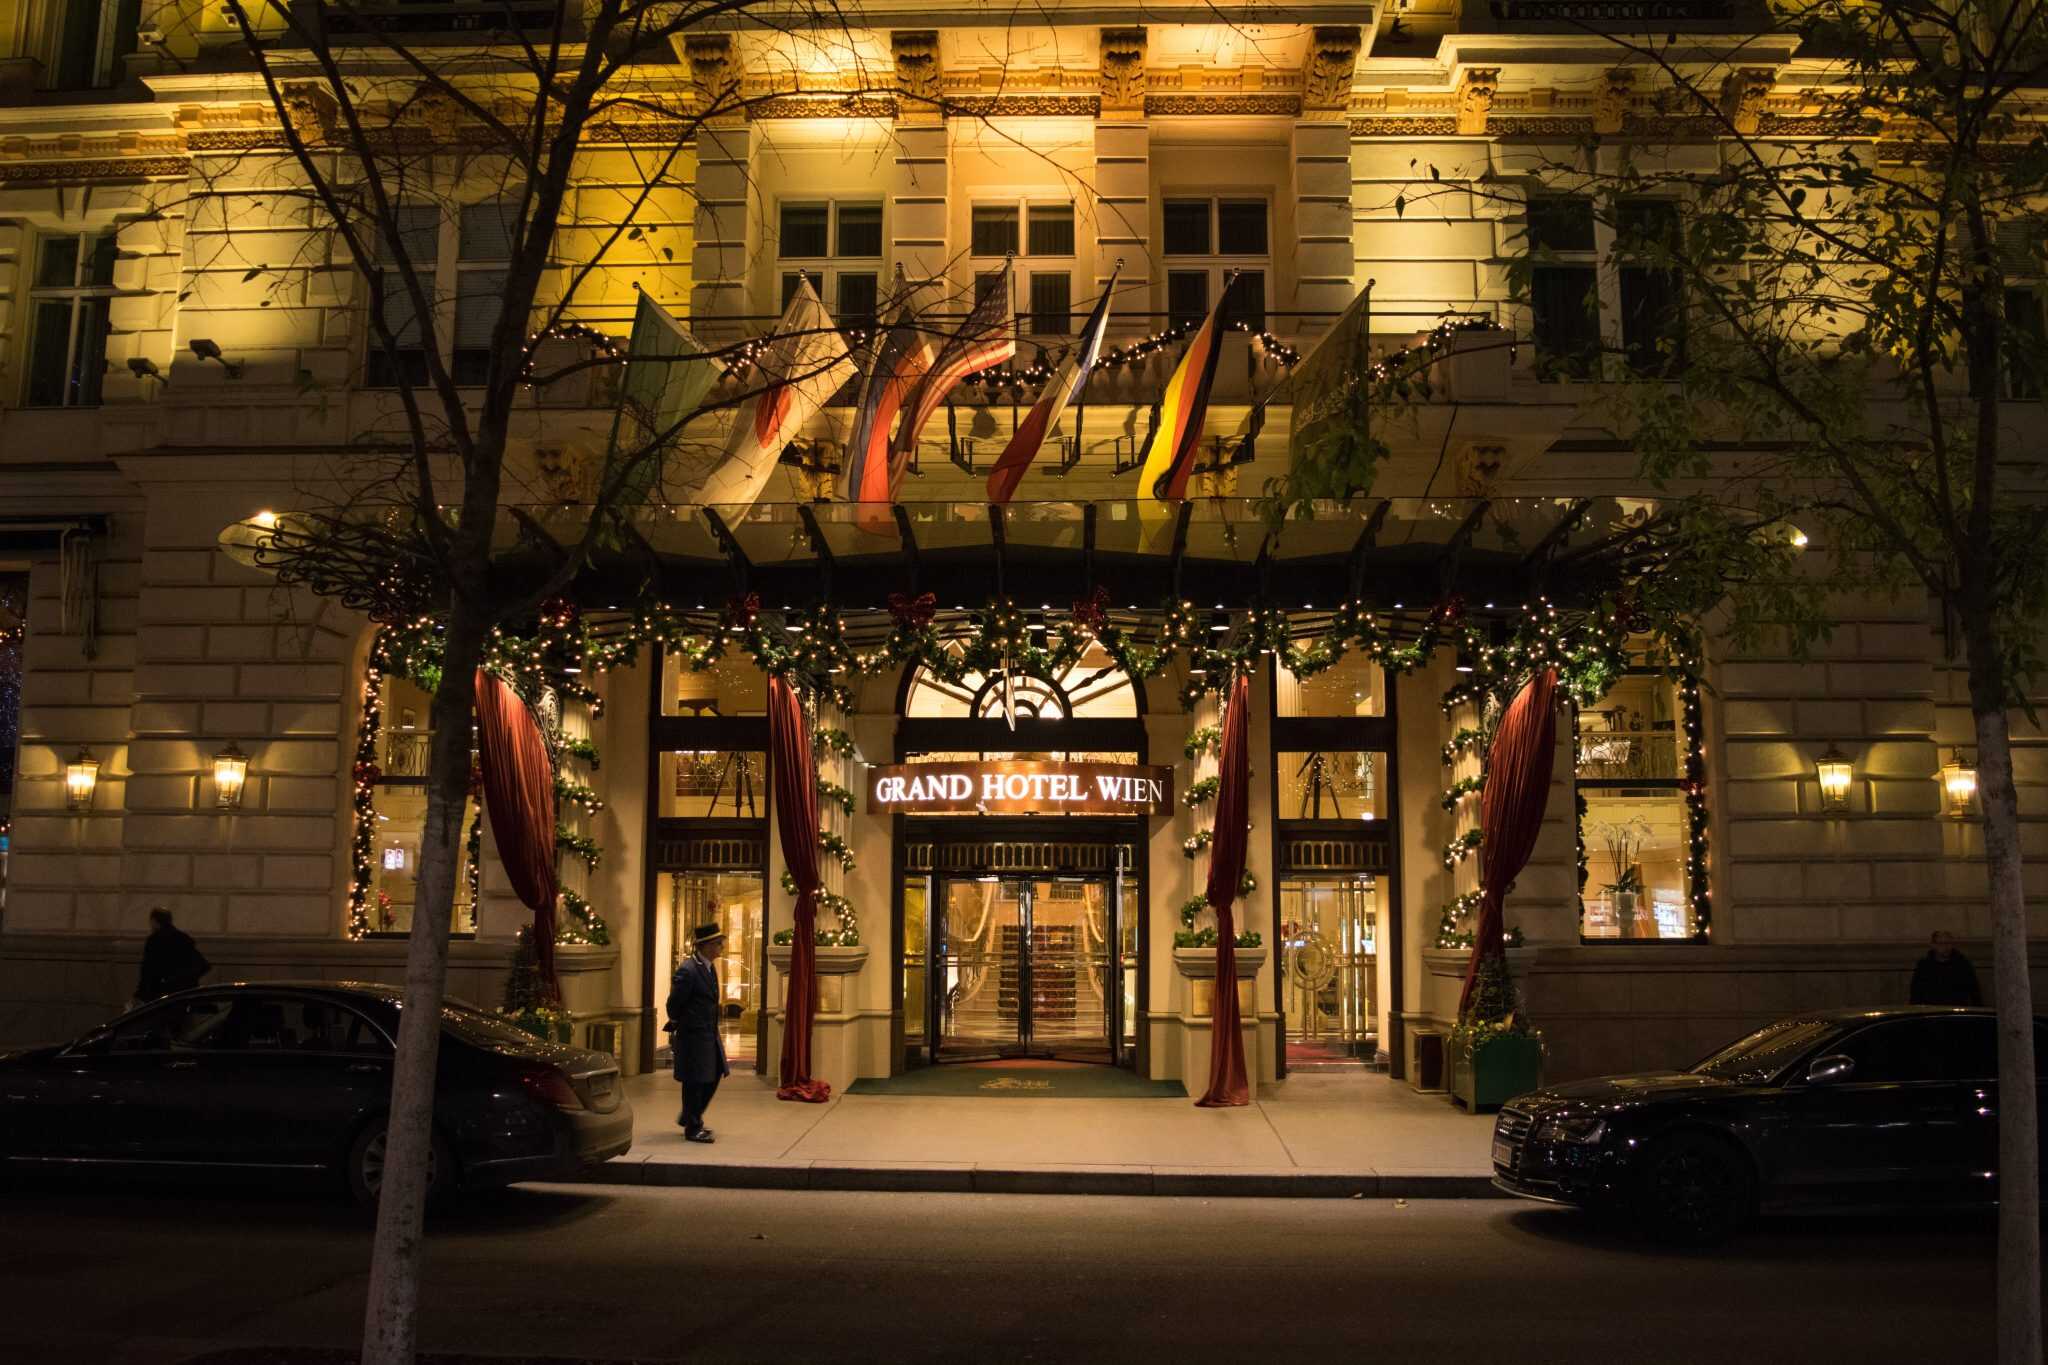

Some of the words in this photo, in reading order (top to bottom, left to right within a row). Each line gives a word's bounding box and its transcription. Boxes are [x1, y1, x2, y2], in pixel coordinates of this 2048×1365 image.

[876, 774, 972, 802] GRAND
[982, 774, 1088, 800] HOTEL
[1096, 776, 1164, 802] WIEN
